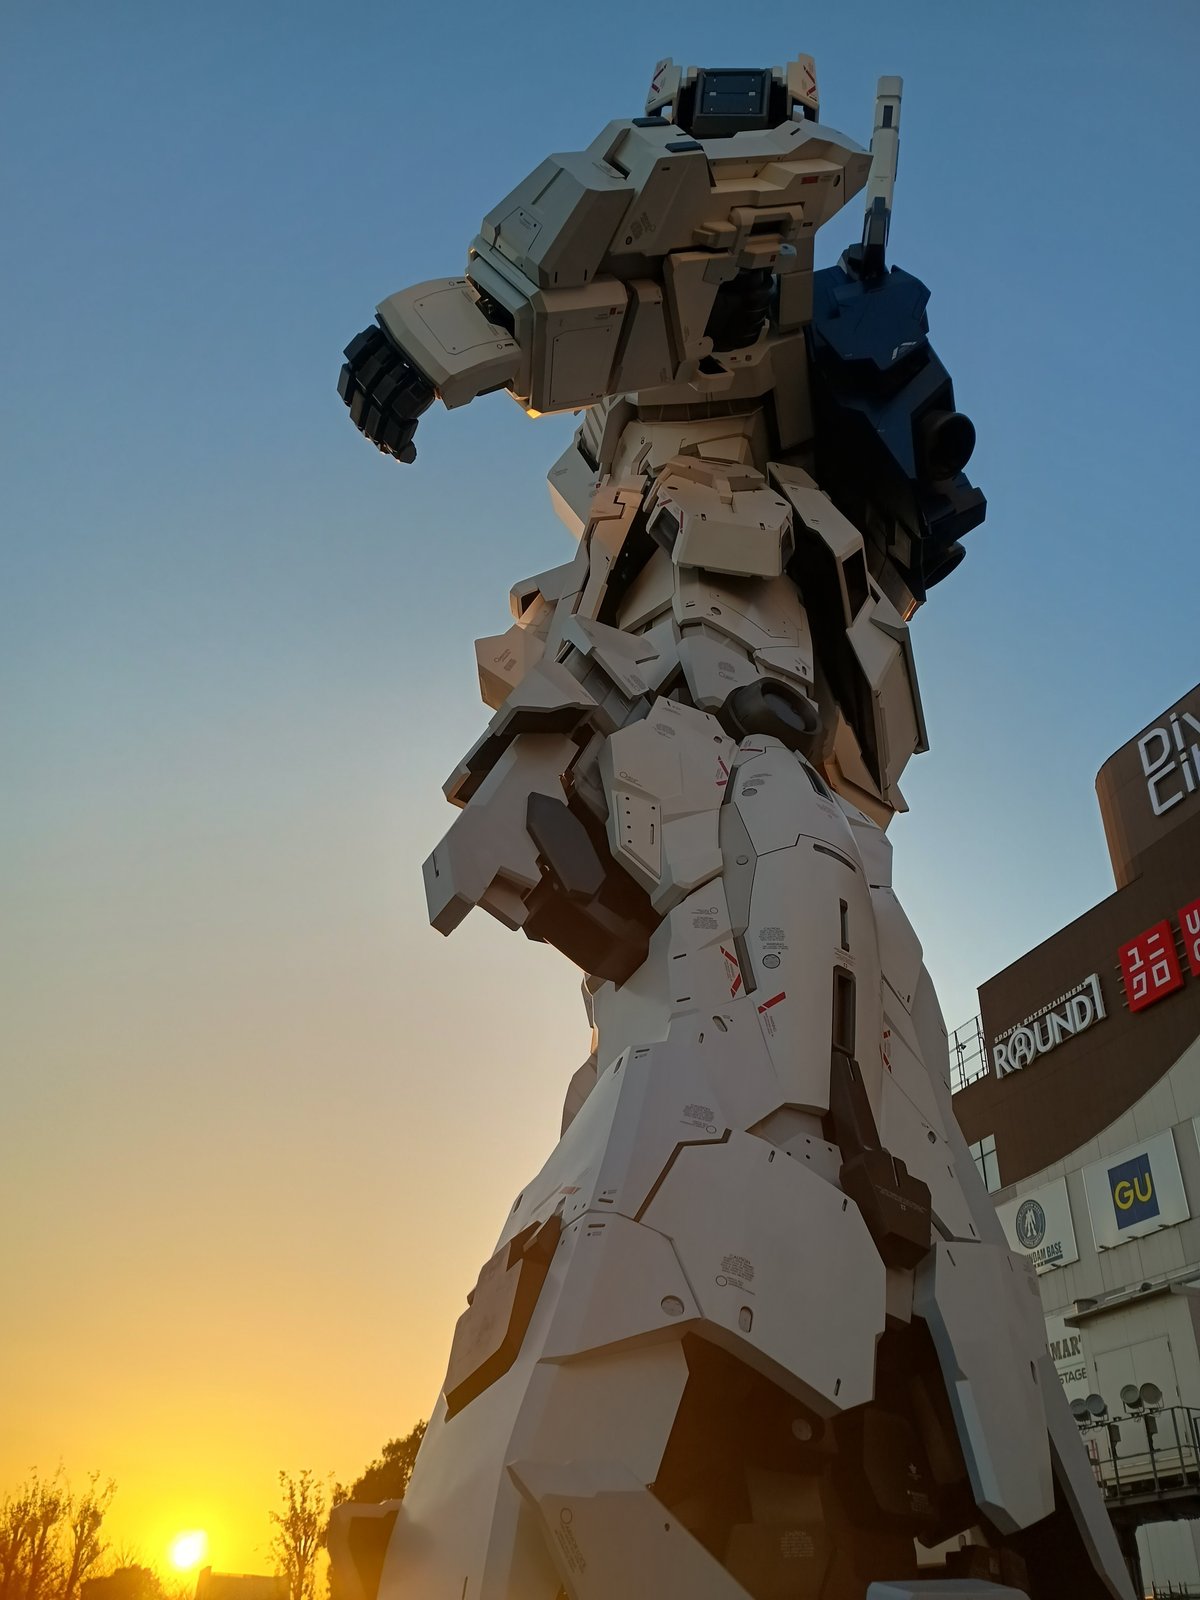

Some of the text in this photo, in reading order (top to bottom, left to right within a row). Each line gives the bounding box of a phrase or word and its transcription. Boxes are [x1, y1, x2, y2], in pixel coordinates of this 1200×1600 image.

[994, 981, 1088, 1044] SPORTS ENTERTAINMENT
[1114, 1172, 1152, 1210] GU
[1046, 1241, 1063, 1258] BASE
[1049, 1334, 1081, 1361] MAR
